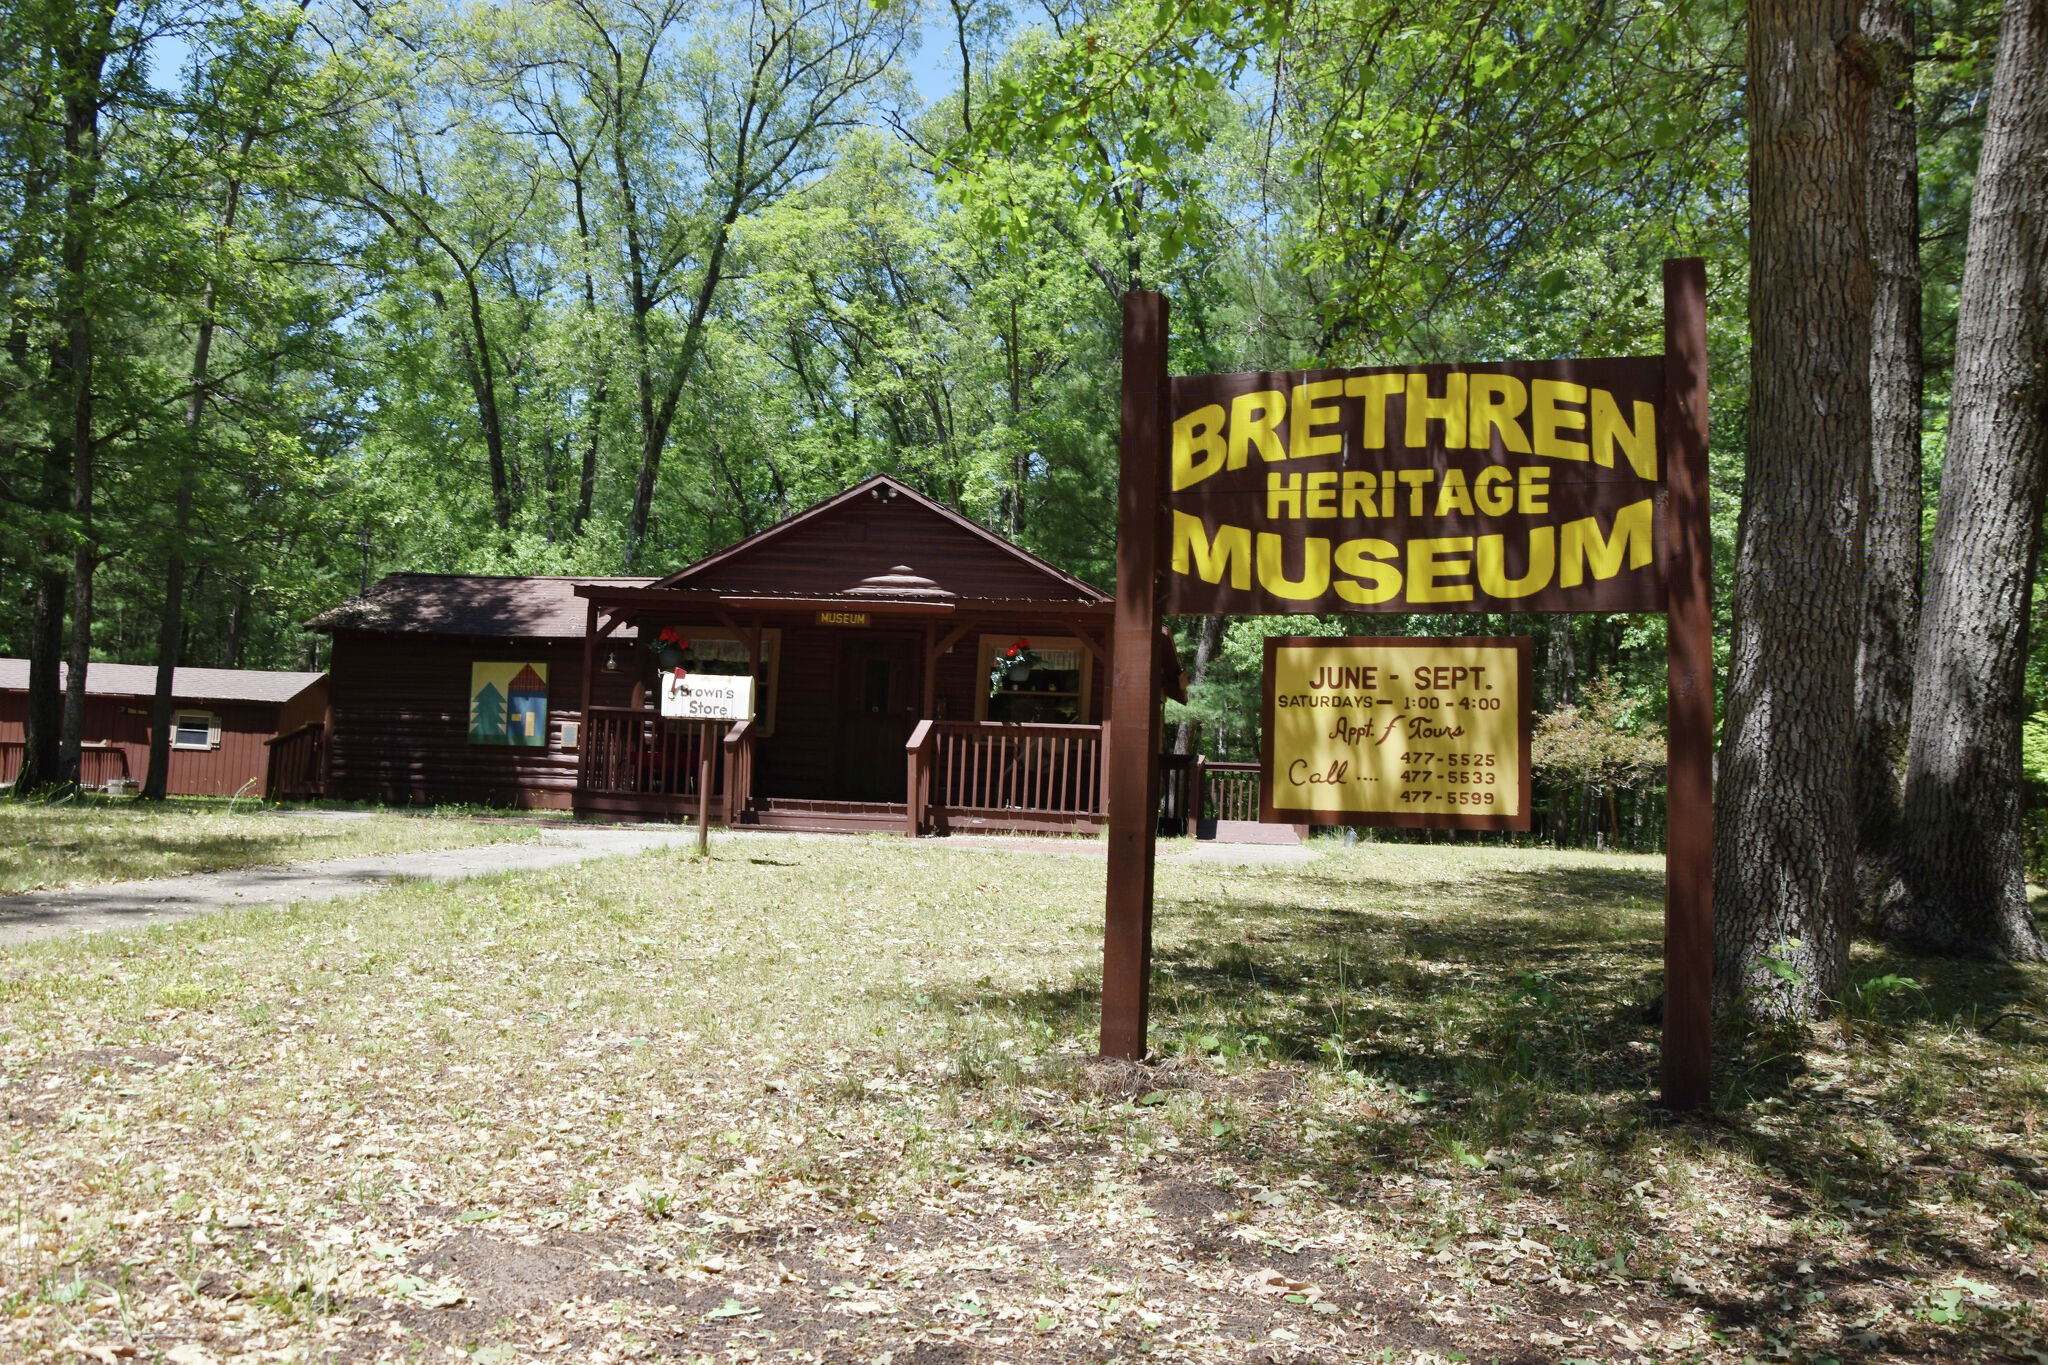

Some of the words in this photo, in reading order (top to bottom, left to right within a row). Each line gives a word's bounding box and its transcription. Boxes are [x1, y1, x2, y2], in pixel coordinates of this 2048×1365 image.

[1173, 373, 1658, 492] BRETHREN
[1267, 465, 1551, 519] HERITAGE
[1172, 499, 1653, 604] MUSEUM
[821, 612, 865, 624] MUSEUM
[1309, 667, 1378, 690] JUNE
[1414, 666, 1493, 690] SEPT.
[689, 700, 728, 715] Store
[1278, 695, 1373, 708] SATURDAYS
[1403, 696, 1440, 710] 1:00
[1458, 697, 1501, 710] 4:00
[1328, 716, 1375, 746] Appt.
[1408, 716, 1465, 740] Tours
[1400, 752, 1496, 767] 477-5525
[1289, 758, 1349, 786] Call
[1400, 771, 1496, 784] 477-5533
[1400, 791, 1495, 805] 477-5599
